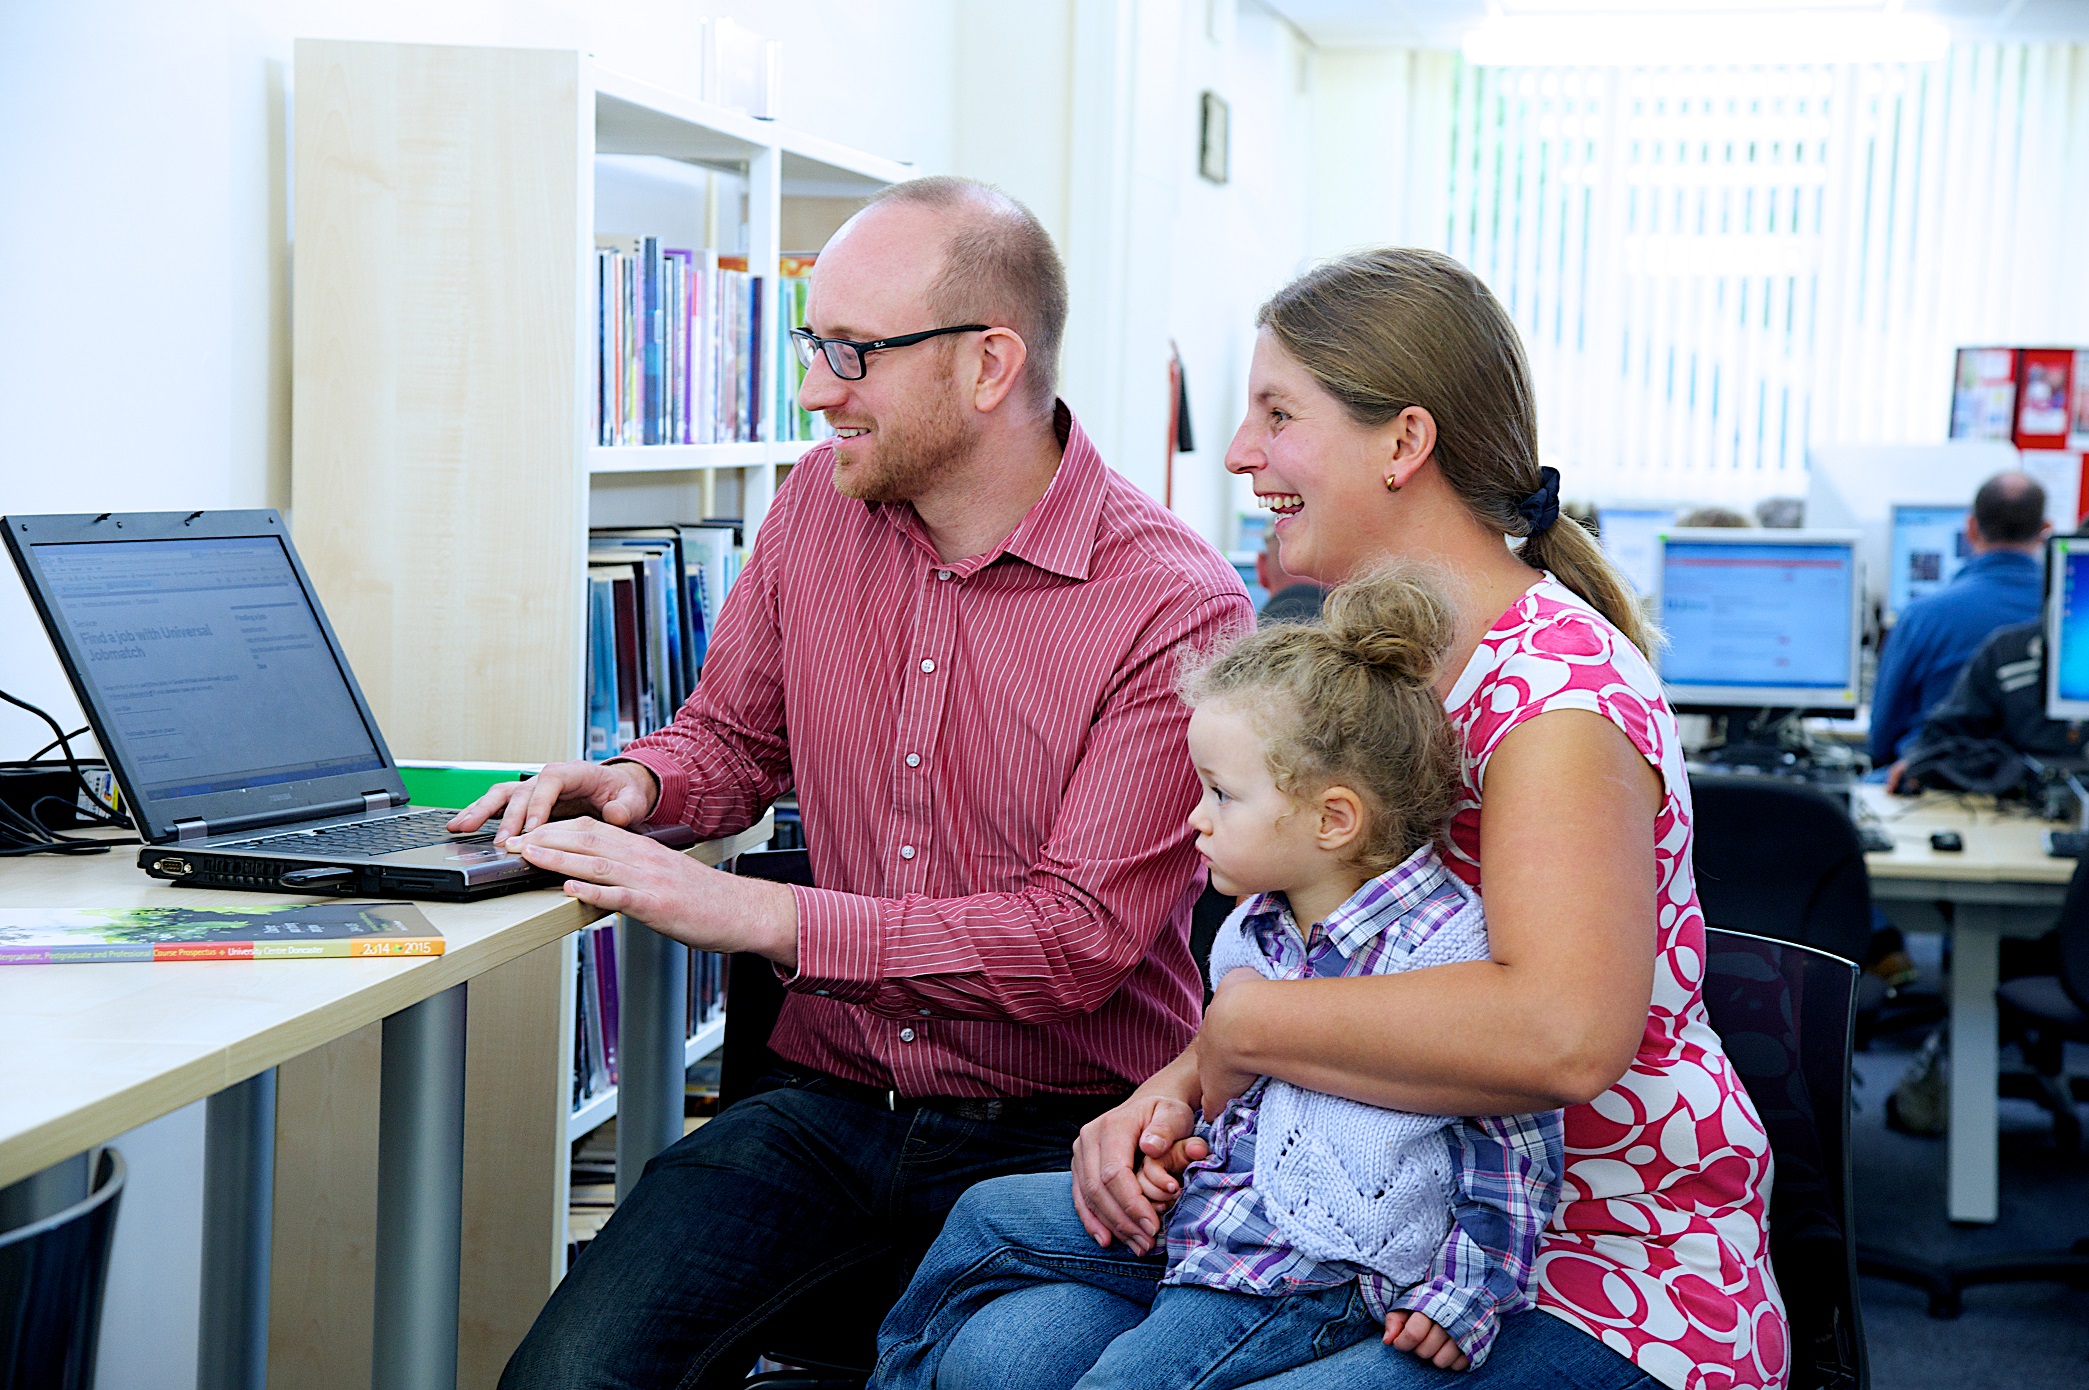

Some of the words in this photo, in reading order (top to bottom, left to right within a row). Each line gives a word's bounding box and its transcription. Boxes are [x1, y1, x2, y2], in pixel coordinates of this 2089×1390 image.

[80, 631, 108, 645] Find
[108, 634, 116, 643] a
[115, 629, 136, 645] job
[135, 627, 162, 641] with
[161, 624, 214, 640] Universal
[89, 646, 147, 662] Jobmatch
[44, 951, 92, 961] Postgraduate
[93, 950, 107, 959] and
[108, 948, 151, 958] Professional
[153, 949, 177, 957] Course
[178, 948, 217, 958] Prospectus
[227, 947, 262, 957] University
[263, 946, 287, 955] Centre
[287, 945, 324, 955] Doncaster
[362, 943, 390, 955] 2014
[404, 942, 432, 954] 2015
